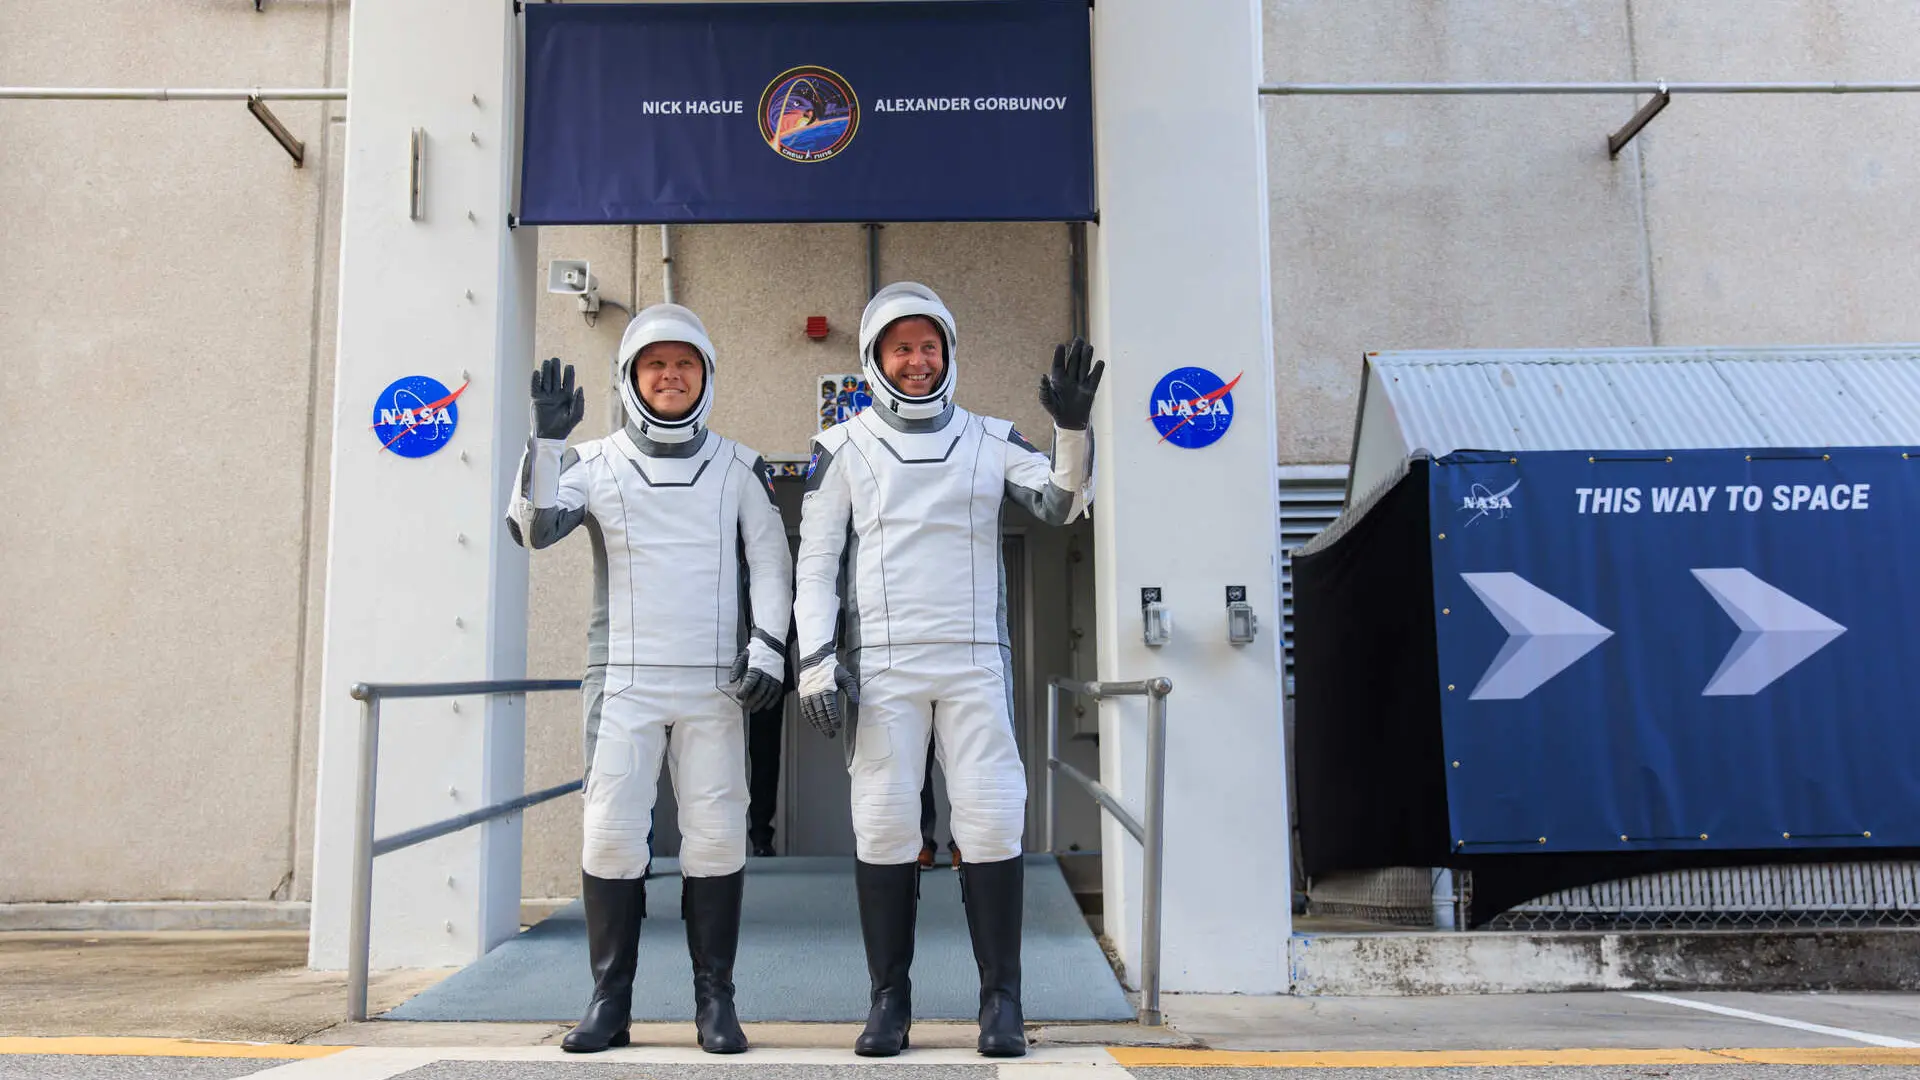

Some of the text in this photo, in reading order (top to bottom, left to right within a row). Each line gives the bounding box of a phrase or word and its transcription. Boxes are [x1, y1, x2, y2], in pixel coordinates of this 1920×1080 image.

[642, 100, 743, 114] NICK HAGUE
[874, 97, 1066, 112] ALEXANDER GORBUNOV
[1157, 398, 1230, 416] NASA
[379, 407, 453, 425] NASA
[1463, 496, 1513, 509] NASA
[1575, 484, 1871, 514] THIS WAY TO SPACE
